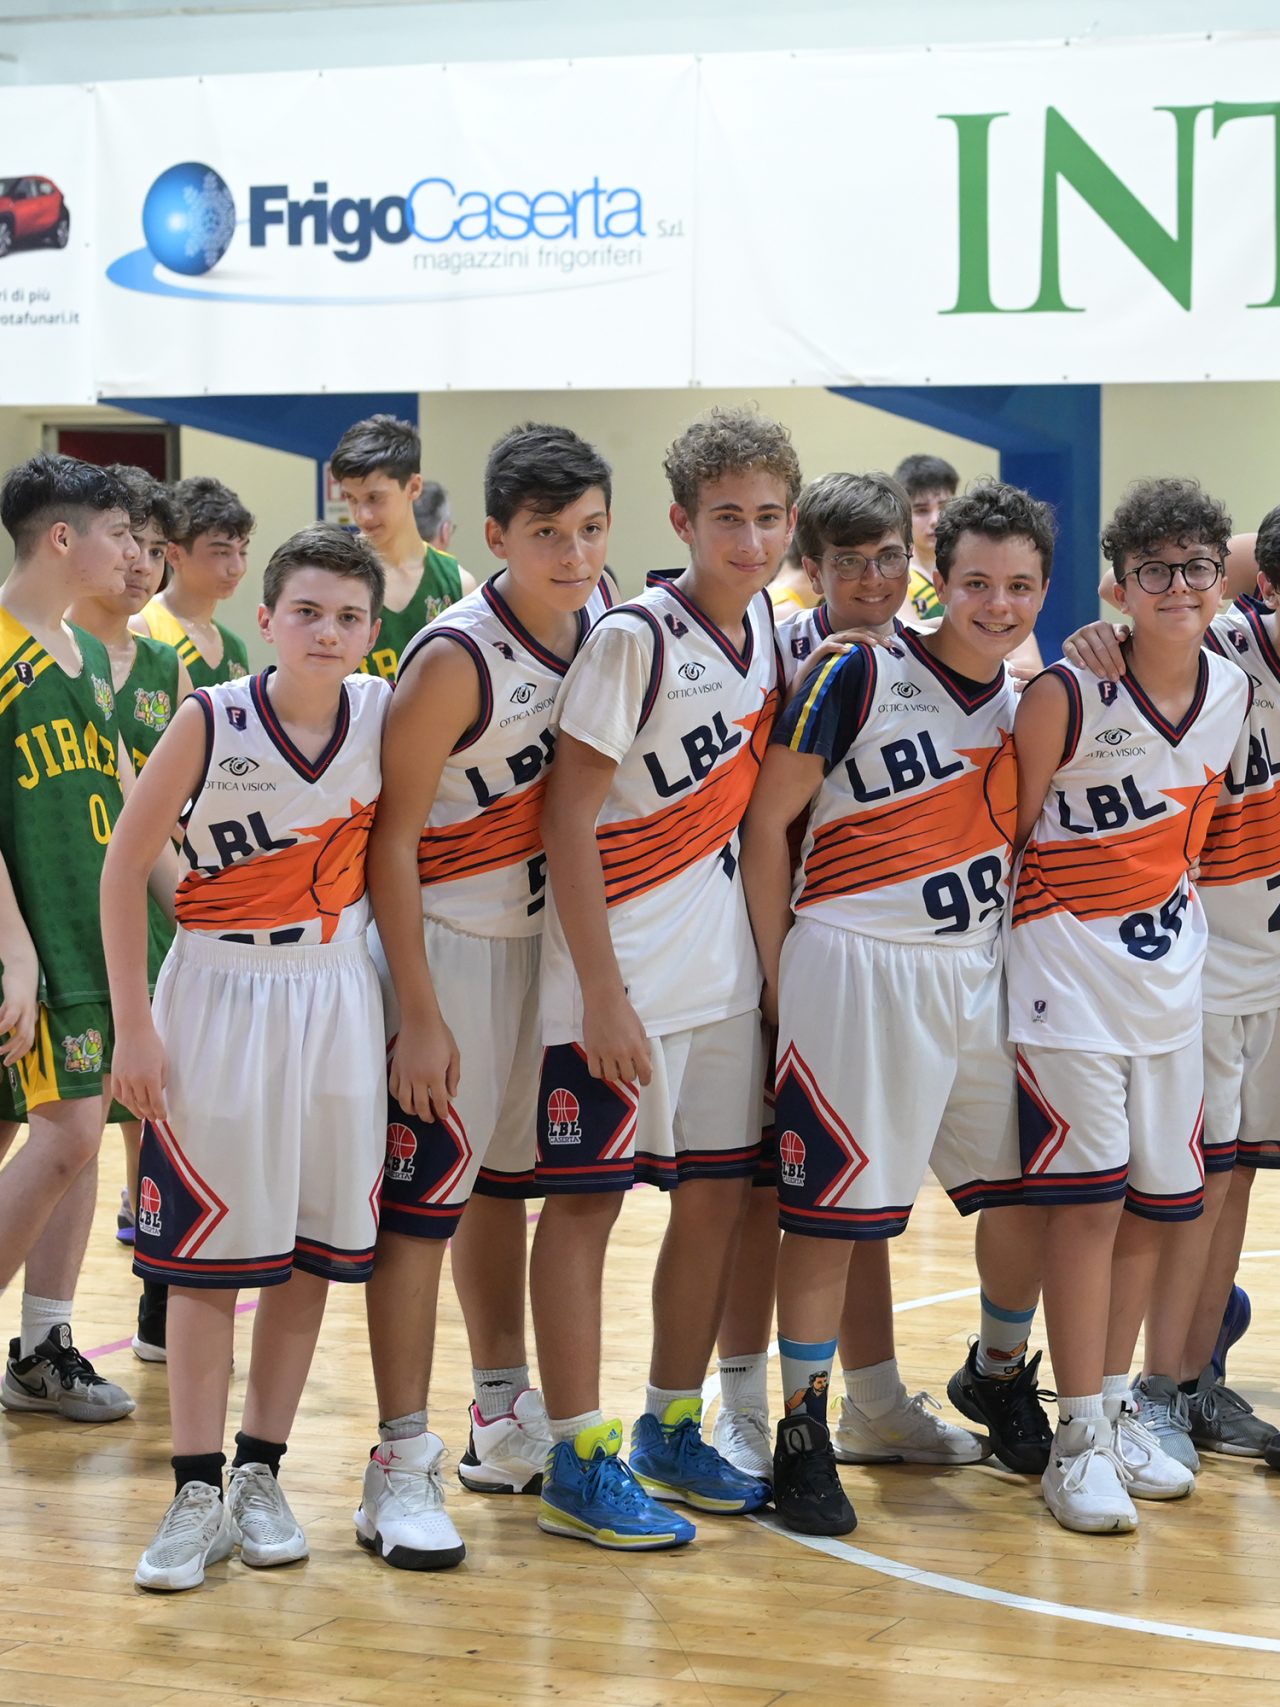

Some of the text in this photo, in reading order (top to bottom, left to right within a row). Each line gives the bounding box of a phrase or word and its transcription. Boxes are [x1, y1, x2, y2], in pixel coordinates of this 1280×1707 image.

[414, 243, 642, 275] magazzini frigoriferi
[11, 287, 24, 302] di
[667, 681, 723, 700] OTTICA VISION
[500, 695, 555, 728] OTTICA VISION
[878, 704, 940, 713] OTTICA VISION
[642, 711, 743, 798] LBL
[1116, 747, 1146, 757] VISION
[845, 730, 964, 803] LBL
[241, 782, 276, 791] VISION
[1055, 774, 1167, 834] LBL
[922, 855, 1005, 935] 99
[549, 1121, 580, 1136] LBL
[782, 1161, 805, 1178] LBL
